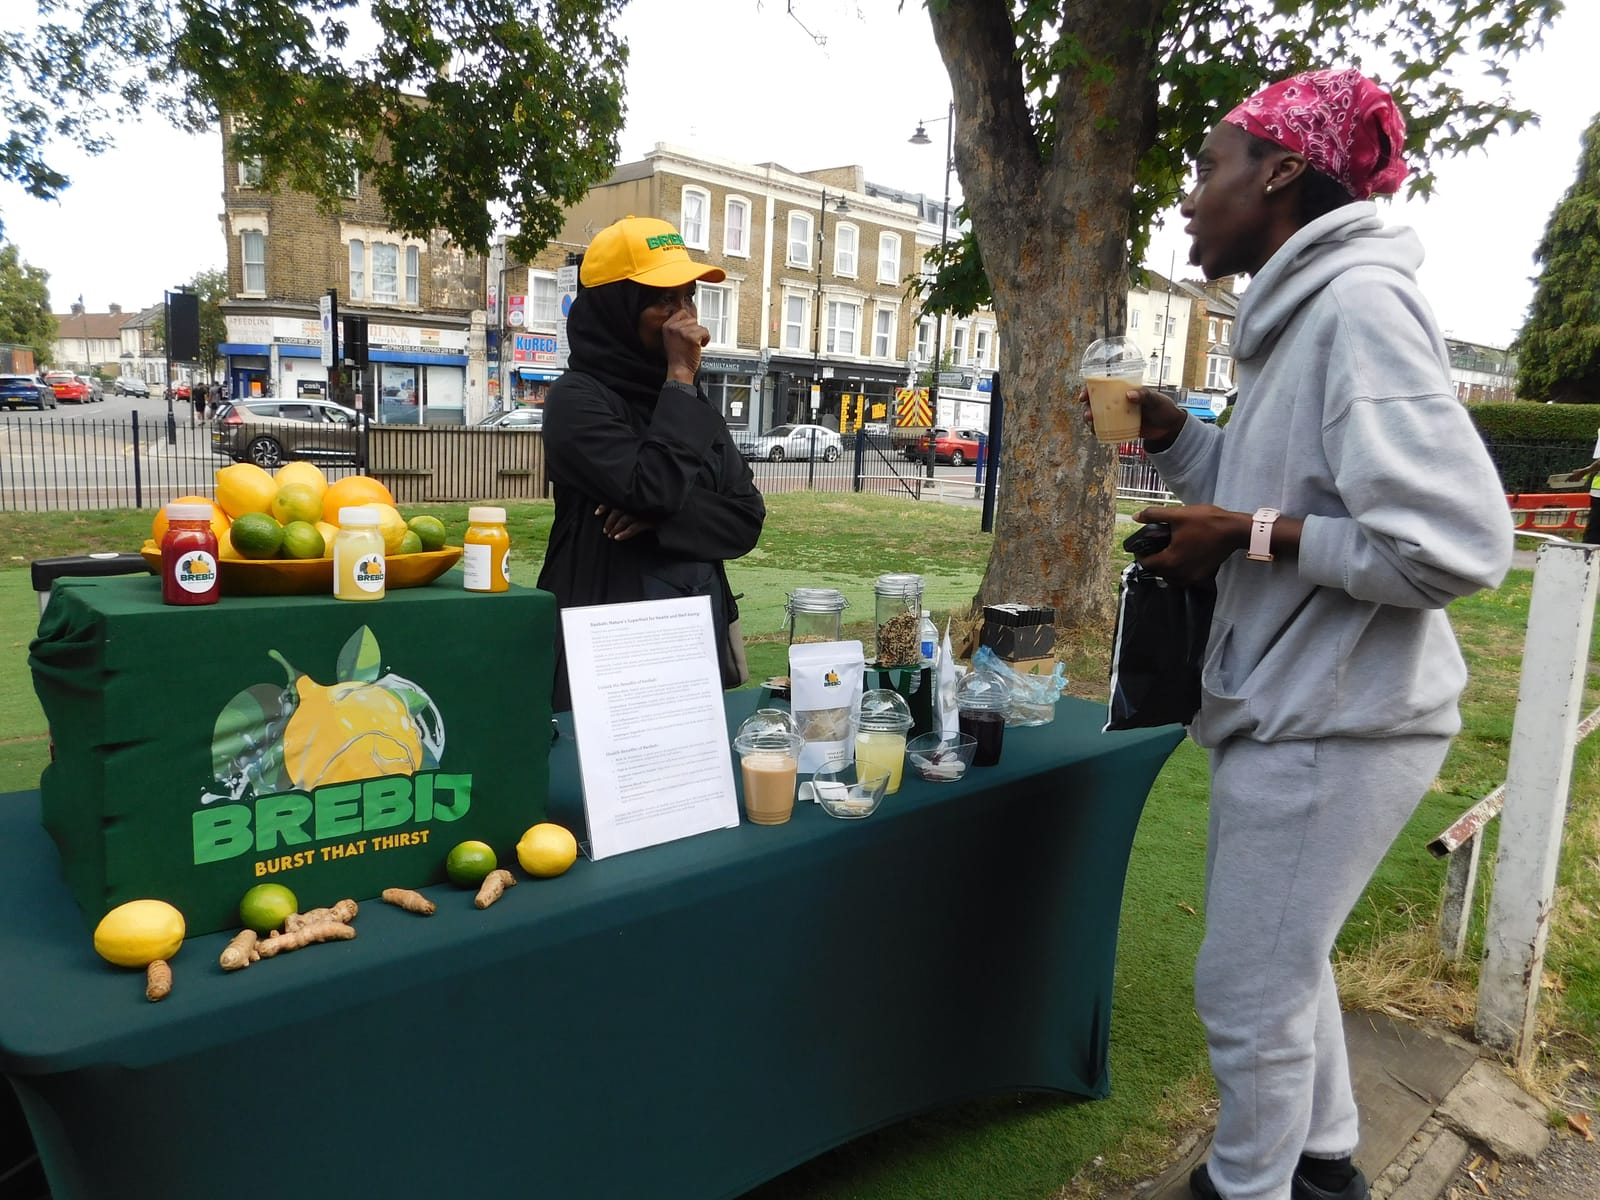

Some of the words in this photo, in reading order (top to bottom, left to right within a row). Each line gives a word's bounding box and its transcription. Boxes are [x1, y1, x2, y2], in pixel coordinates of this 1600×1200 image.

[192, 773, 473, 865] BREBIJ
[254, 849, 315, 877] BURST
[320, 840, 367, 862] THAT
[371, 830, 430, 849] THIRST
